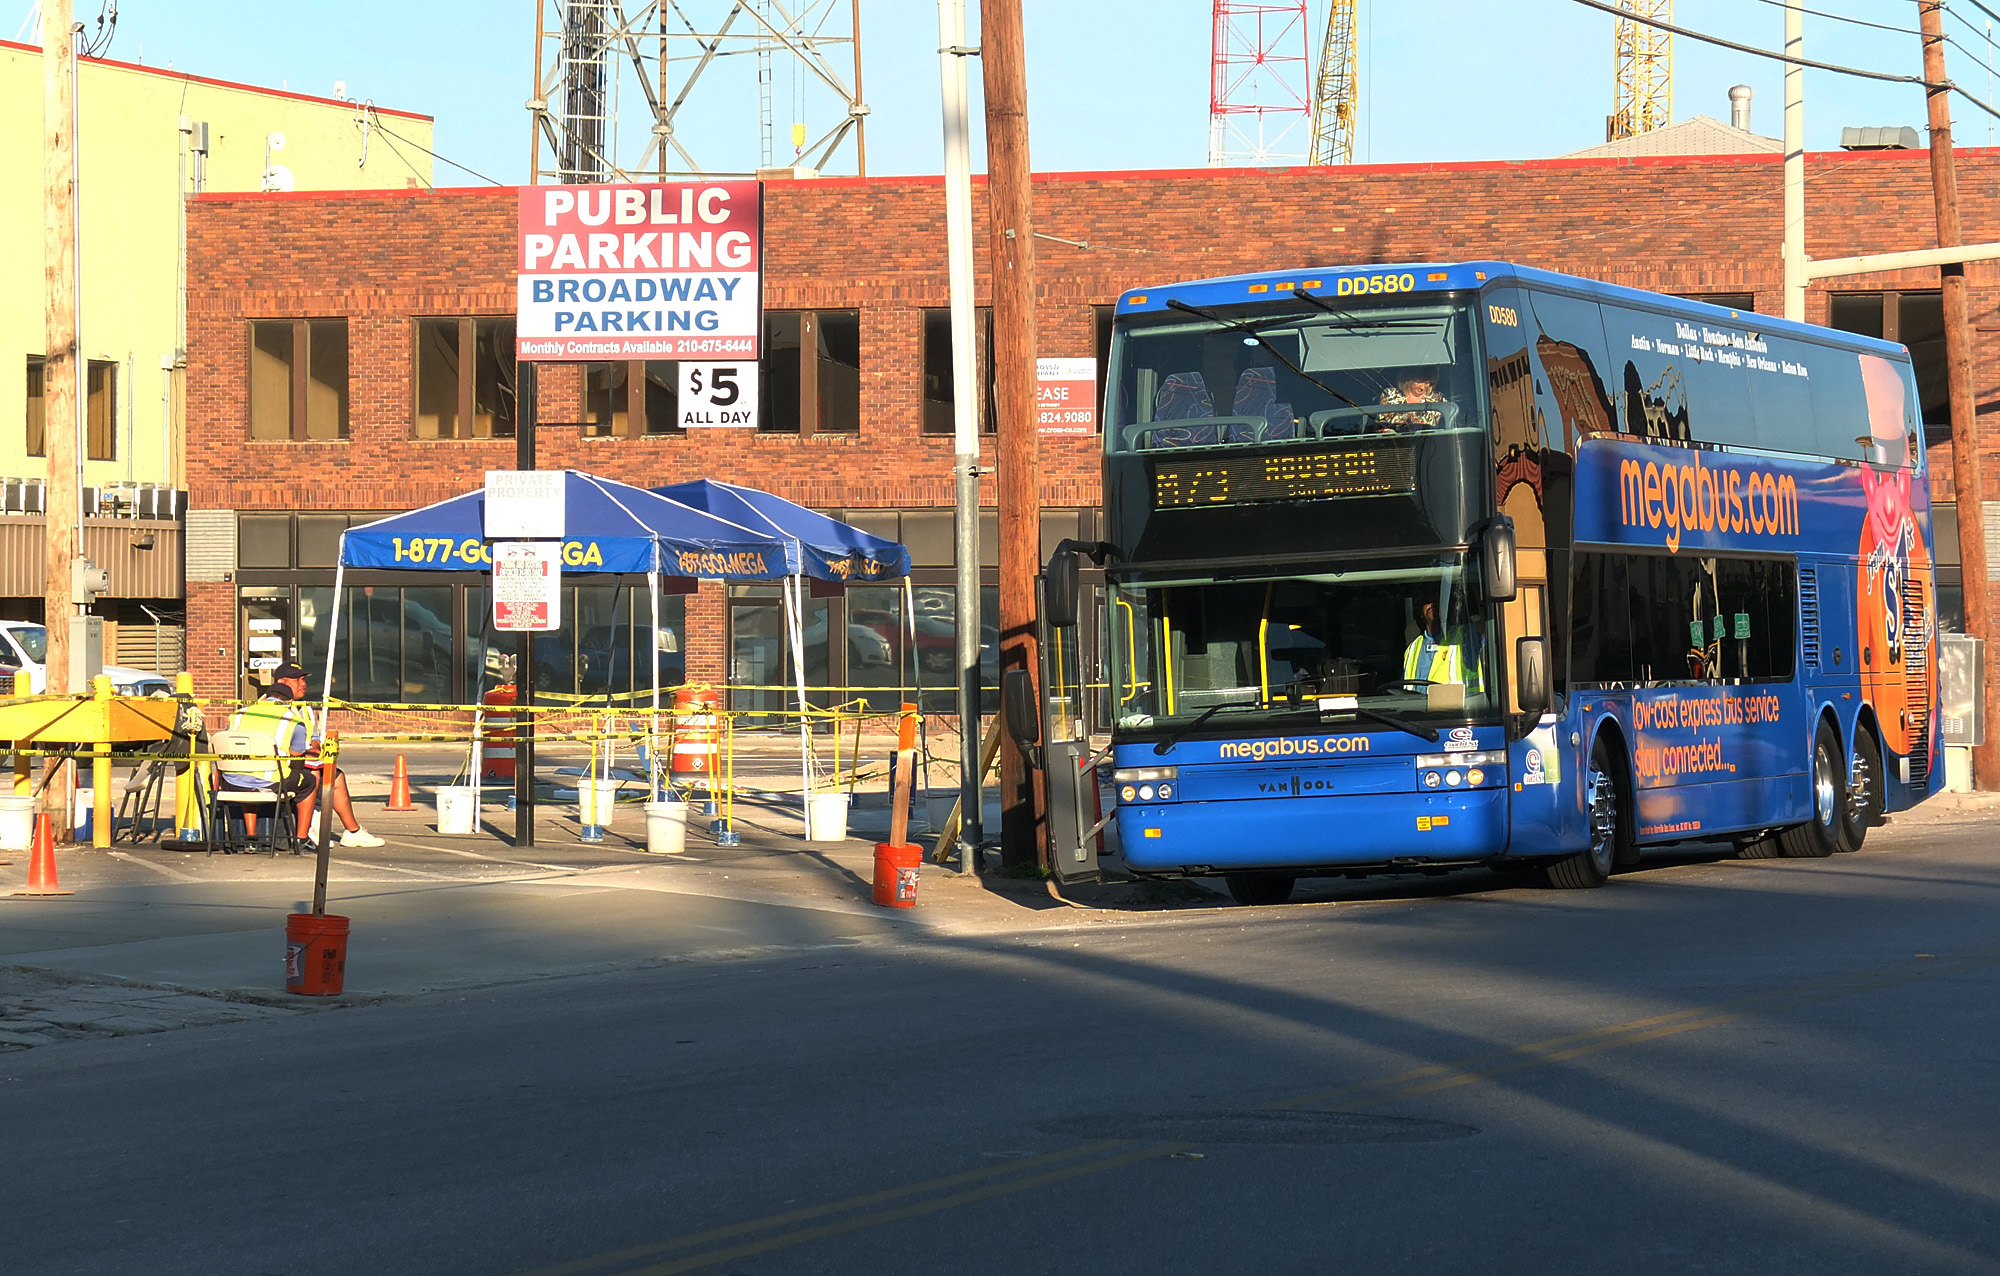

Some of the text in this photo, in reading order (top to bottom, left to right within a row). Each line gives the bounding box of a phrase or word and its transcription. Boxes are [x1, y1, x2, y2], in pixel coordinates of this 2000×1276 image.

[545, 187, 732, 226] PUBLIC
[524, 230, 752, 270] PARKING
[532, 277, 741, 303] BROADWAY
[1337, 273, 1415, 297] DD580
[554, 310, 719, 332] PARKING
[1488, 304, 1518, 327] DD580
[521, 339, 753, 356] Monthly Contracts Available 210-675-6444
[1675, 322, 1768, 354] Dallas Houston San Antonio
[1631, 334, 1651, 351] Austin
[1656, 338, 1680, 356] Norman
[1685, 343, 1700, 360] Little
[1700, 345, 1714, 362] Rock
[1717, 349, 1742, 369] Memphis
[1746, 354, 1757, 369] New
[1757, 356, 1777, 373] Orleans
[1781, 360, 1798, 376] Baton
[1037, 386, 1069, 401] EASE
[684, 411, 751, 424] ALL DAY
[1266, 452, 1375, 481] HOUSTON
[488, 487, 561, 498] PROPERTY
[495, 474, 553, 486] PRIVATE
[1620, 449, 1800, 553] megabus.com
[675, 549, 768, 575] 1-877-GO2-MEGA
[1632, 689, 1780, 735] low-cost express bus service
[1220, 736, 1370, 761] megabus.com
[1635, 741, 1661, 786] stay
[1258, 775, 1335, 796] VAN HOOL
